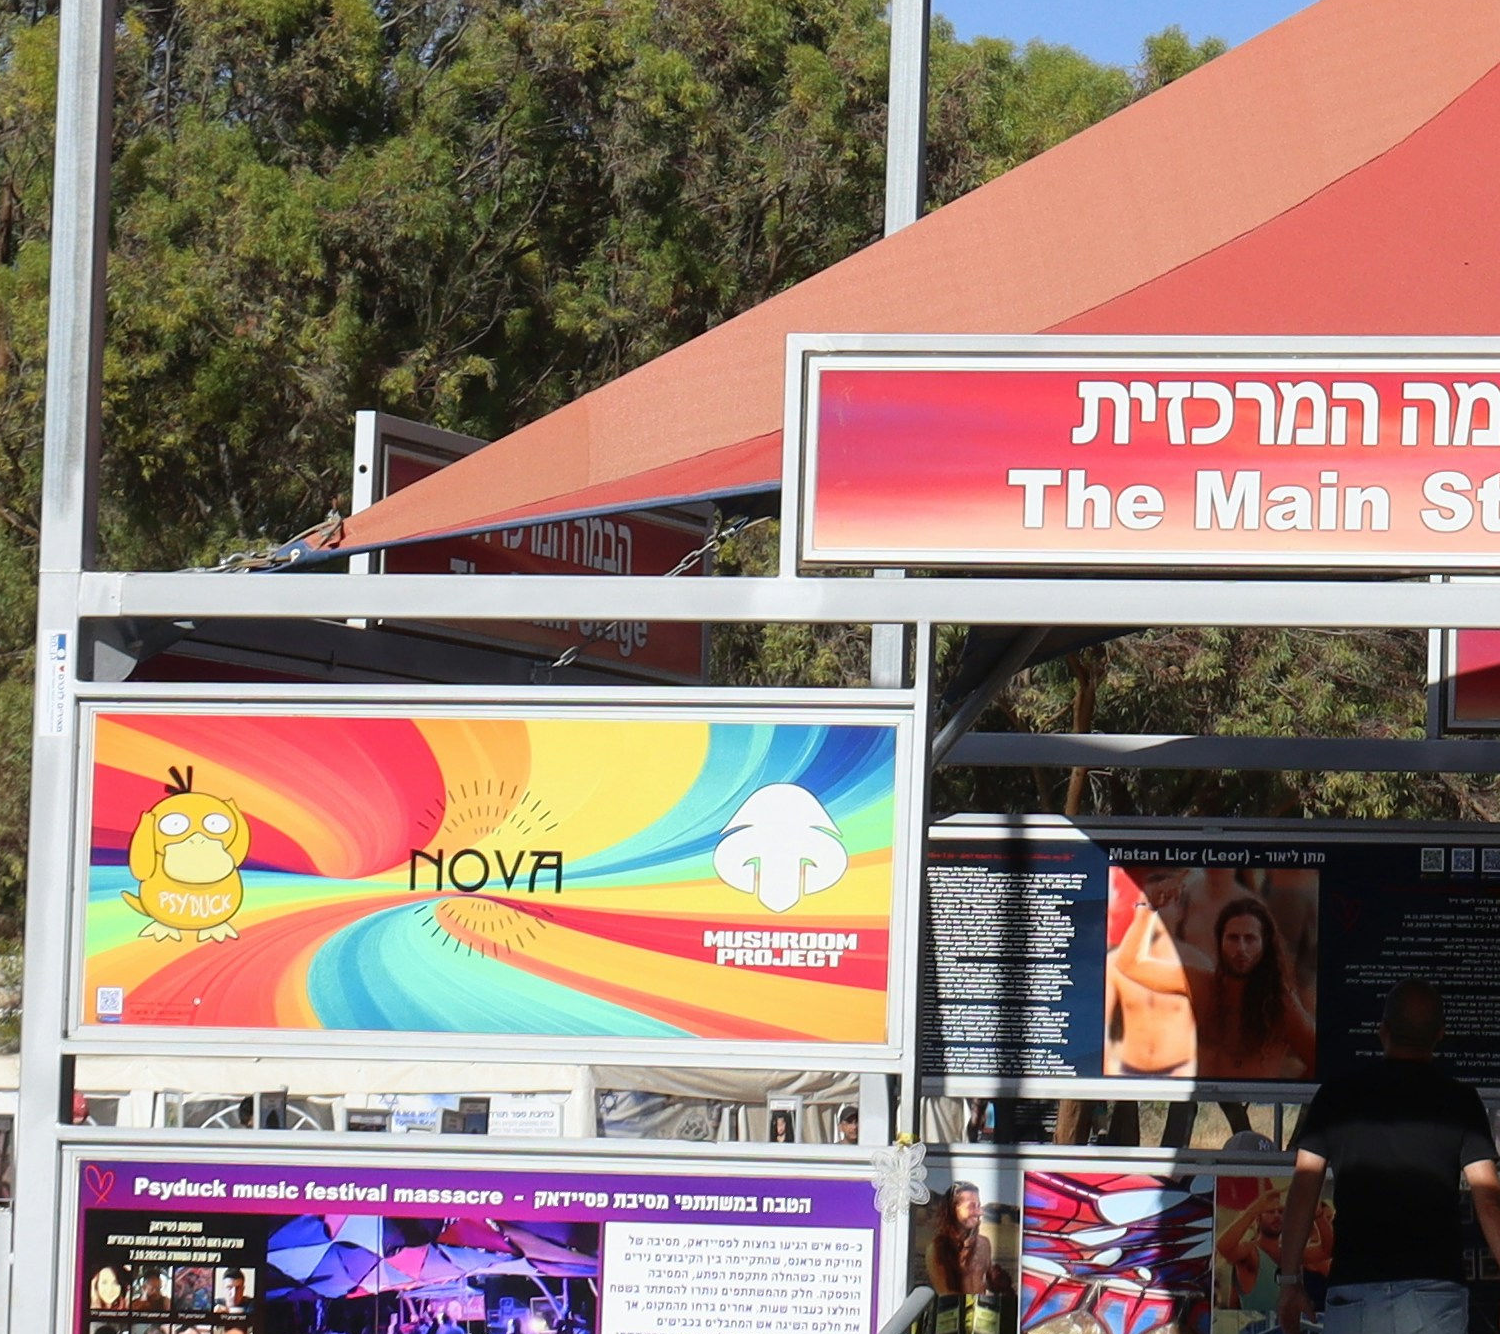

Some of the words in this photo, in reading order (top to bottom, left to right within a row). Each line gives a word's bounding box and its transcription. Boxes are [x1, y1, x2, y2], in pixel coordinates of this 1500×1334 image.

[1072, 381, 1377, 444] המרכזית
[1008, 469, 1163, 531] The
[1195, 471, 1390, 532] Main
[1108, 847, 1159, 860] Matan
[1165, 848, 1197, 860] Lior
[1201, 848, 1249, 864] (Leor)
[1265, 849, 1298, 862] ליאור
[1302, 852, 1325, 864] מתן
[410, 849, 562, 894] NOVA
[159, 890, 233, 917] PSYDUCK
[704, 930, 858, 952] MUSHROOM
[715, 949, 844, 968] PROJECT
[134, 1177, 225, 1199] Psyduck
[233, 1180, 297, 1199] music
[306, 1181, 385, 1201] festival
[394, 1188, 501, 1204] massacre
[534, 1191, 608, 1208] פסיידאק
[613, 1193, 668, 1209] מסיבת
[674, 1194, 757, 1211] במשתתפי
[762, 1197, 810, 1213] הטבח
[628, 1235, 643, 1245] של
[647, 1237, 679, 1246] מסיבה
[742, 1239, 775, 1249] בחצות
[779, 1241, 807, 1249] הגיעו
[811, 1242, 831, 1250] איש
[624, 1252, 650, 1262] נירים
[654, 1253, 702, 1264] הקיבוצים
[707, 1255, 721, 1264] בין
[725, 1255, 780, 1266] שהתקיימה
[825, 1258, 861, 1268] מוזיקת
[648, 1269, 688, 1278] המסיבה
[728, 1271, 767, 1281] מתקפת
[771, 1271, 815, 1282] כשהחלה
[843, 1274, 861, 1283] וניר
[609, 1283, 639, 1293] בשטח
[644, 1284, 686, 1294] להסתתר
[691, 1286, 717, 1295] נותרו
[721, 1287, 787, 1297] מהמשתתפים
[791, 1287, 812, 1299] חלק
[625, 1300, 638, 1310] אך
[691, 1302, 715, 1311] ברחו
[719, 1303, 752, 1312] אחרים
[791, 1305, 823, 1314] כעבור
[827, 1304, 860, 1315] וחולצו
[656, 1317, 701, 1327] בכבישים
[705, 1317, 752, 1328] המחבלים
[755, 1320, 771, 1328] אש
[775, 1321, 807, 1330] השיגה
[811, 1320, 840, 1332] חלקם
[844, 1323, 859, 1331] את
